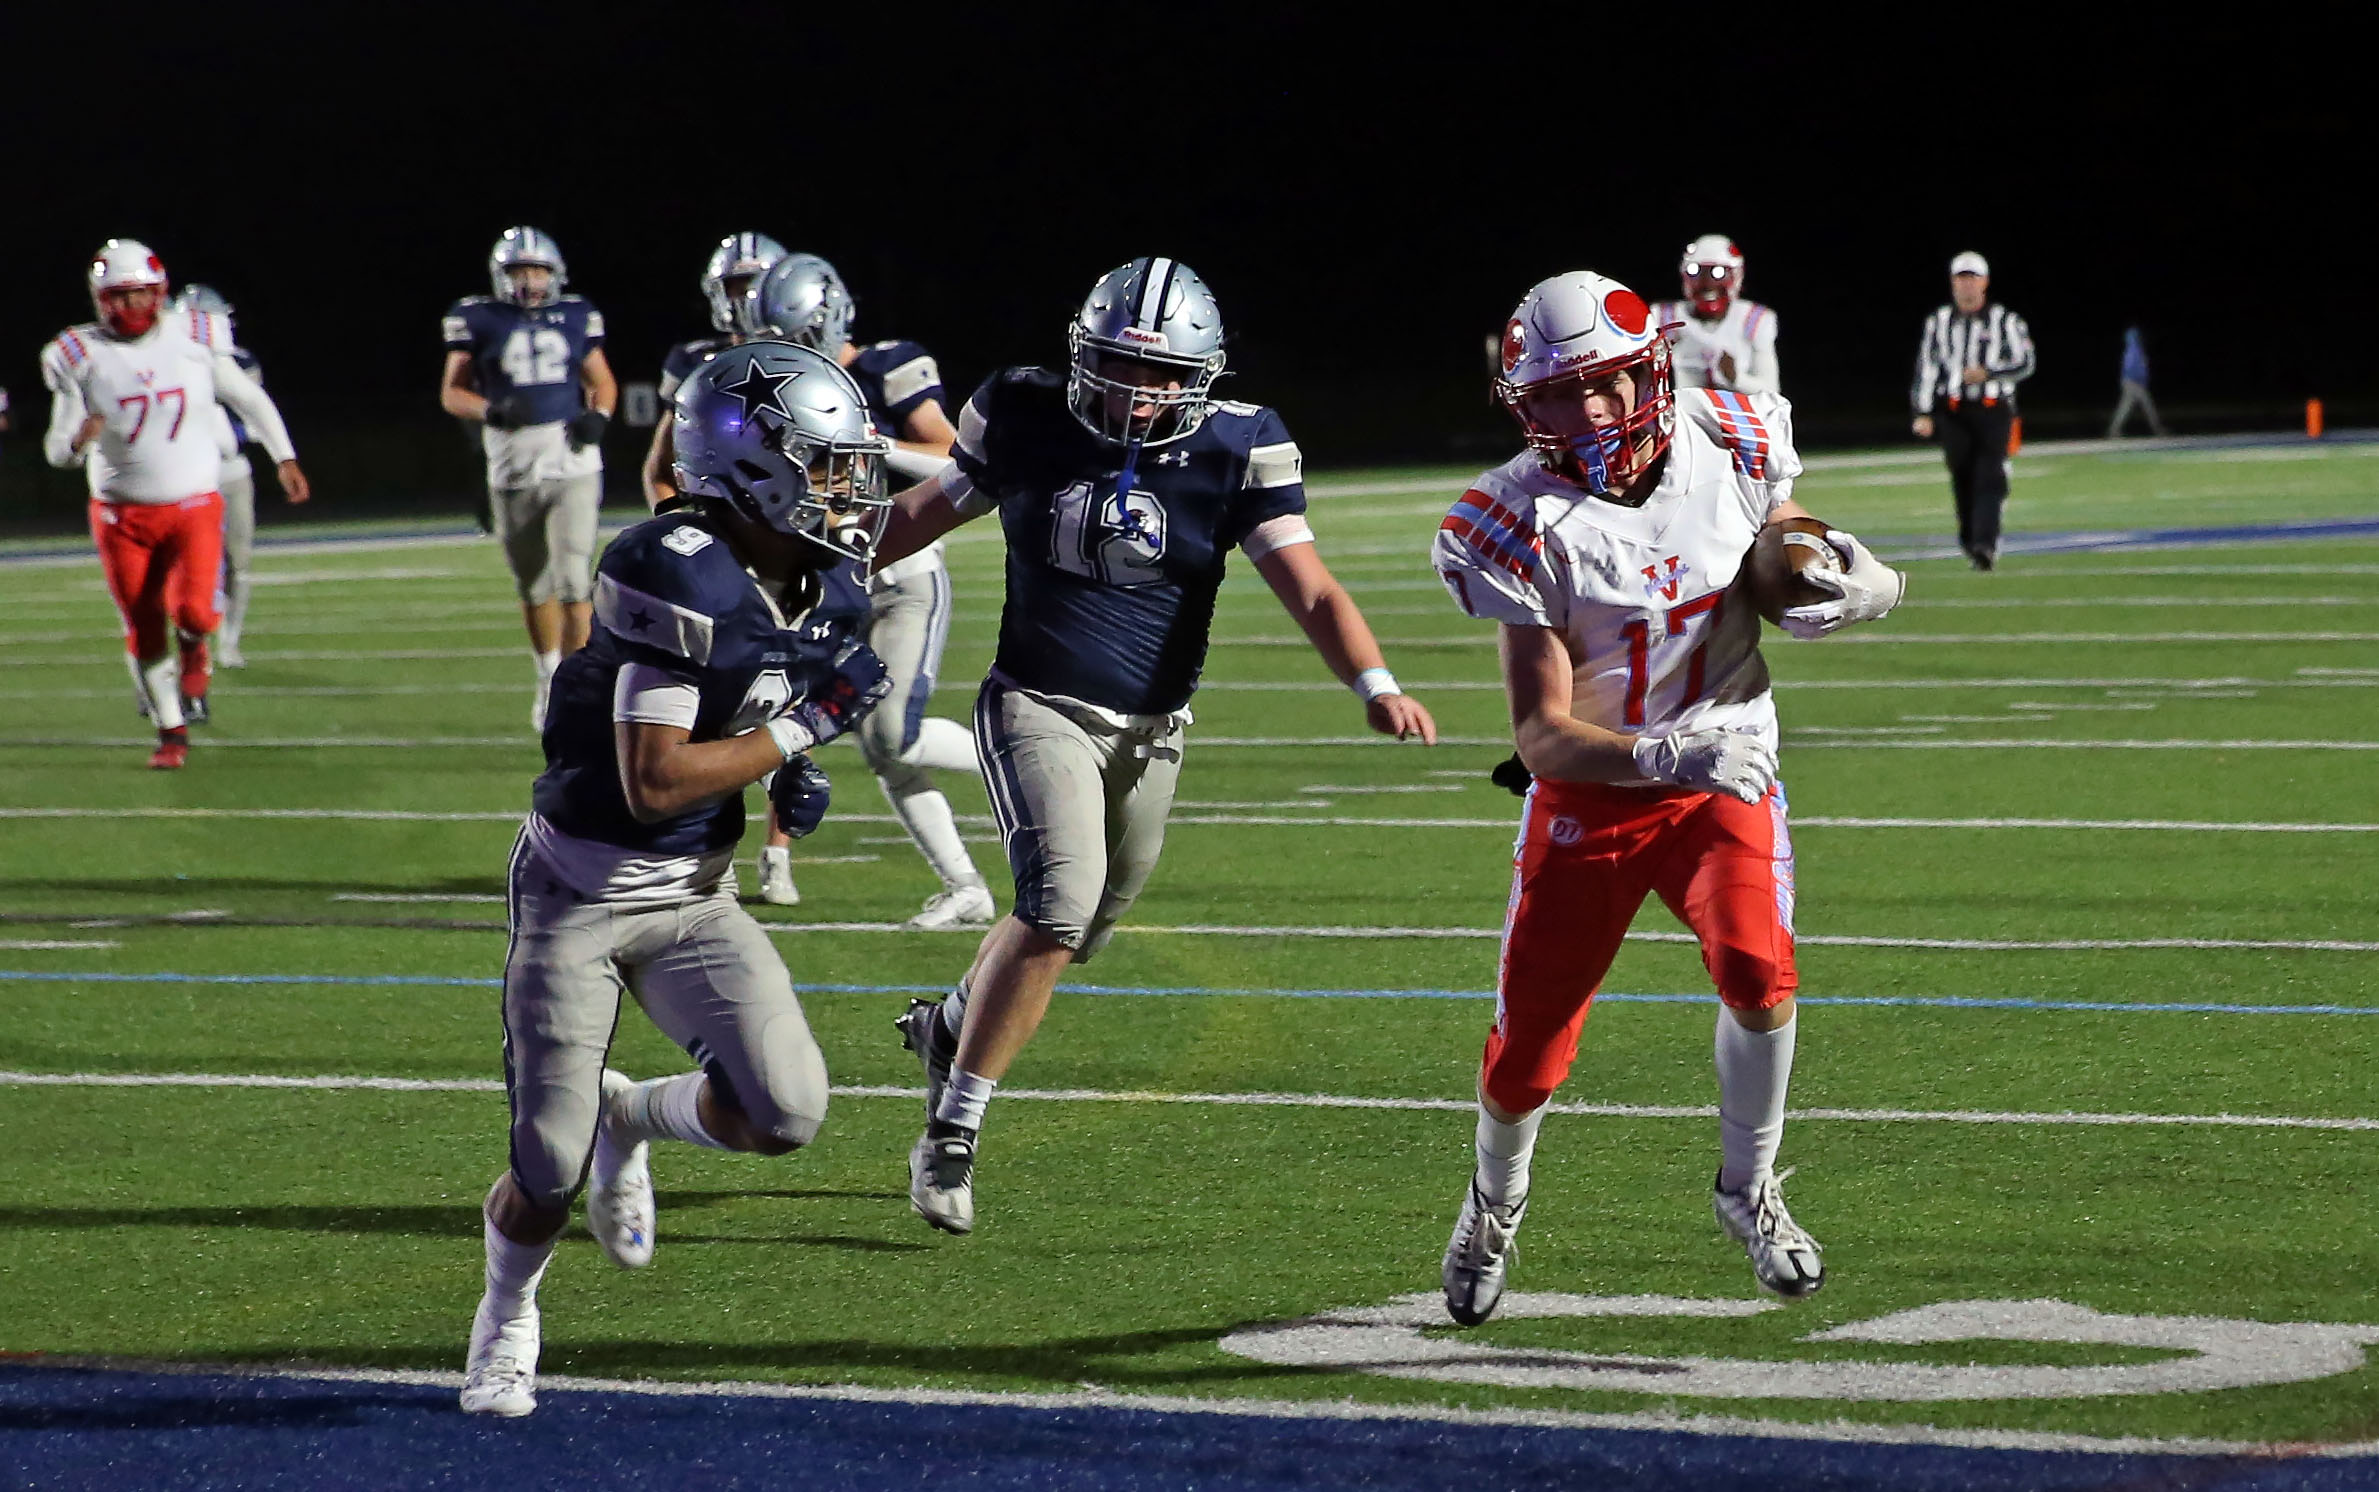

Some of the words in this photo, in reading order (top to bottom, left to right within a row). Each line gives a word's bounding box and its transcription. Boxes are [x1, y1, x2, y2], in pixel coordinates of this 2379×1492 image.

[501, 328, 570, 386] 42
[118, 388, 186, 444] 77
[1048, 480, 1168, 588] 12
[1617, 587, 1725, 730] 17
